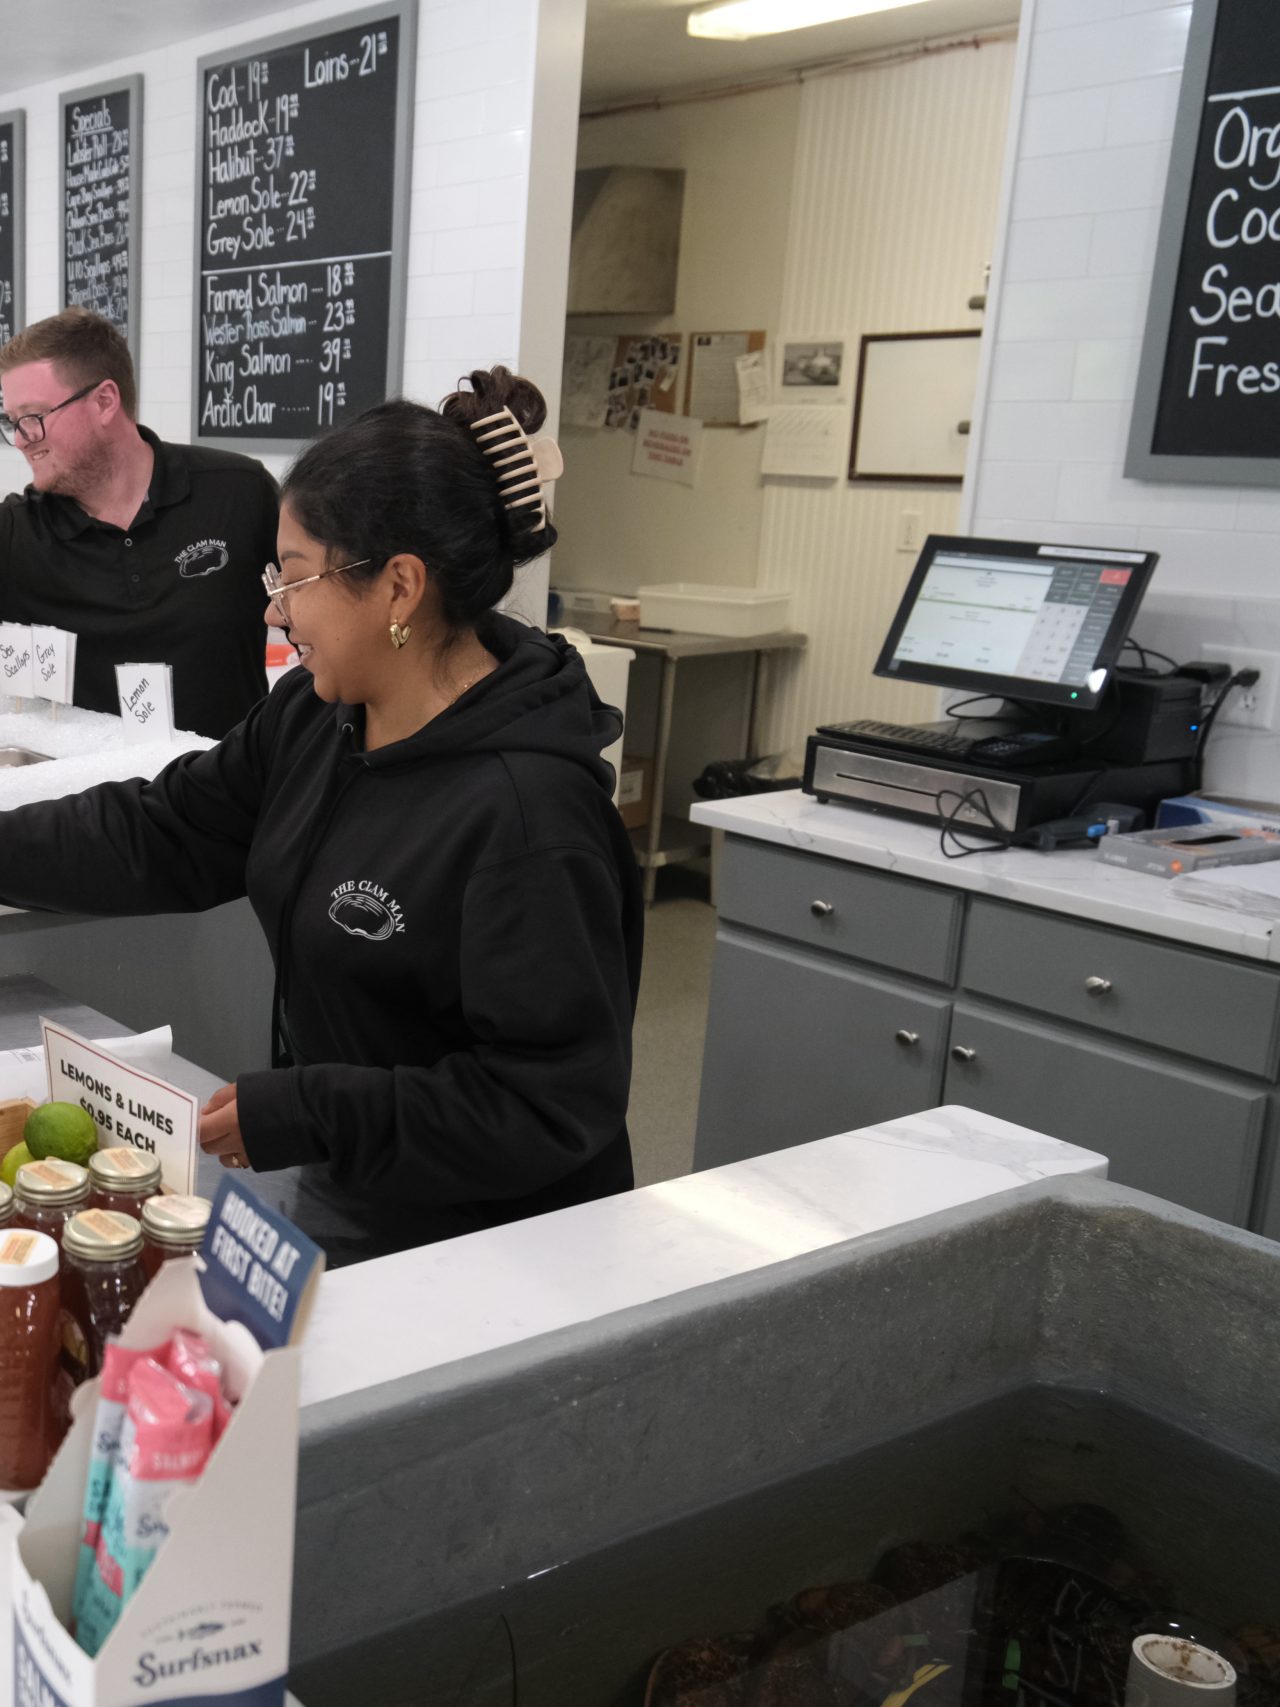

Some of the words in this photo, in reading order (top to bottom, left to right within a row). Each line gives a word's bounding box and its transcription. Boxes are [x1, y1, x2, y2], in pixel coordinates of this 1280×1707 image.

[304, 48, 349, 88] Loins
[359, 33, 377, 76] 21
[207, 67, 238, 112] Cod
[248, 62, 261, 103] 19
[72, 98, 111, 141] Specials
[276, 95, 289, 134] 19
[208, 139, 258, 185] Halibut
[263, 135, 284, 172] 37
[208, 187, 250, 221] Lemon
[250, 174, 282, 213] Sole
[288, 170, 308, 207] 22
[207, 223, 241, 260] Grey
[242, 213, 275, 250] Sole
[286, 209, 306, 242] 24
[206, 274, 253, 313] Farmed
[257, 271, 307, 307] Salmon
[327, 265, 342, 297] 18
[203, 314, 242, 346] Wester
[271, 304, 306, 338] Salmon
[323, 302, 345, 332] 23
[205, 350, 235, 397] King
[239, 342, 291, 376] Salmon
[320, 338, 341, 374] 39
[1188, 335, 1280, 398] Fres
[201, 389, 243, 428] Arctic
[244, 384, 276, 425] Char
[318, 382, 334, 426] 19
[173, 549, 189, 563] THE
[186, 539, 207, 552] CLAM
[208, 538, 227, 548] MAN
[0, 644, 15, 660] Sea
[4, 650, 30, 678] Scallops
[36, 643, 56, 665] Grey
[40, 663, 57, 682] Sole
[122, 677, 150, 712] Lemon
[134, 701, 156, 724] Sole
[330, 880, 356, 899] THE
[358, 880, 390, 902] CLAM
[386, 898, 406, 933] MAN
[60, 1059, 112, 1103] LEMONS
[115, 1092, 125, 1110] &
[128, 1098, 174, 1136] LIMES
[79, 1096, 113, 1132] $0.95
[116, 1122, 156, 1154] EACH
[210, 1225, 253, 1284] FIRST
[220, 1190, 280, 1263] HOOKED
[271, 1240, 301, 1281] AT
[133, 1639, 263, 1688] Surfsnax
